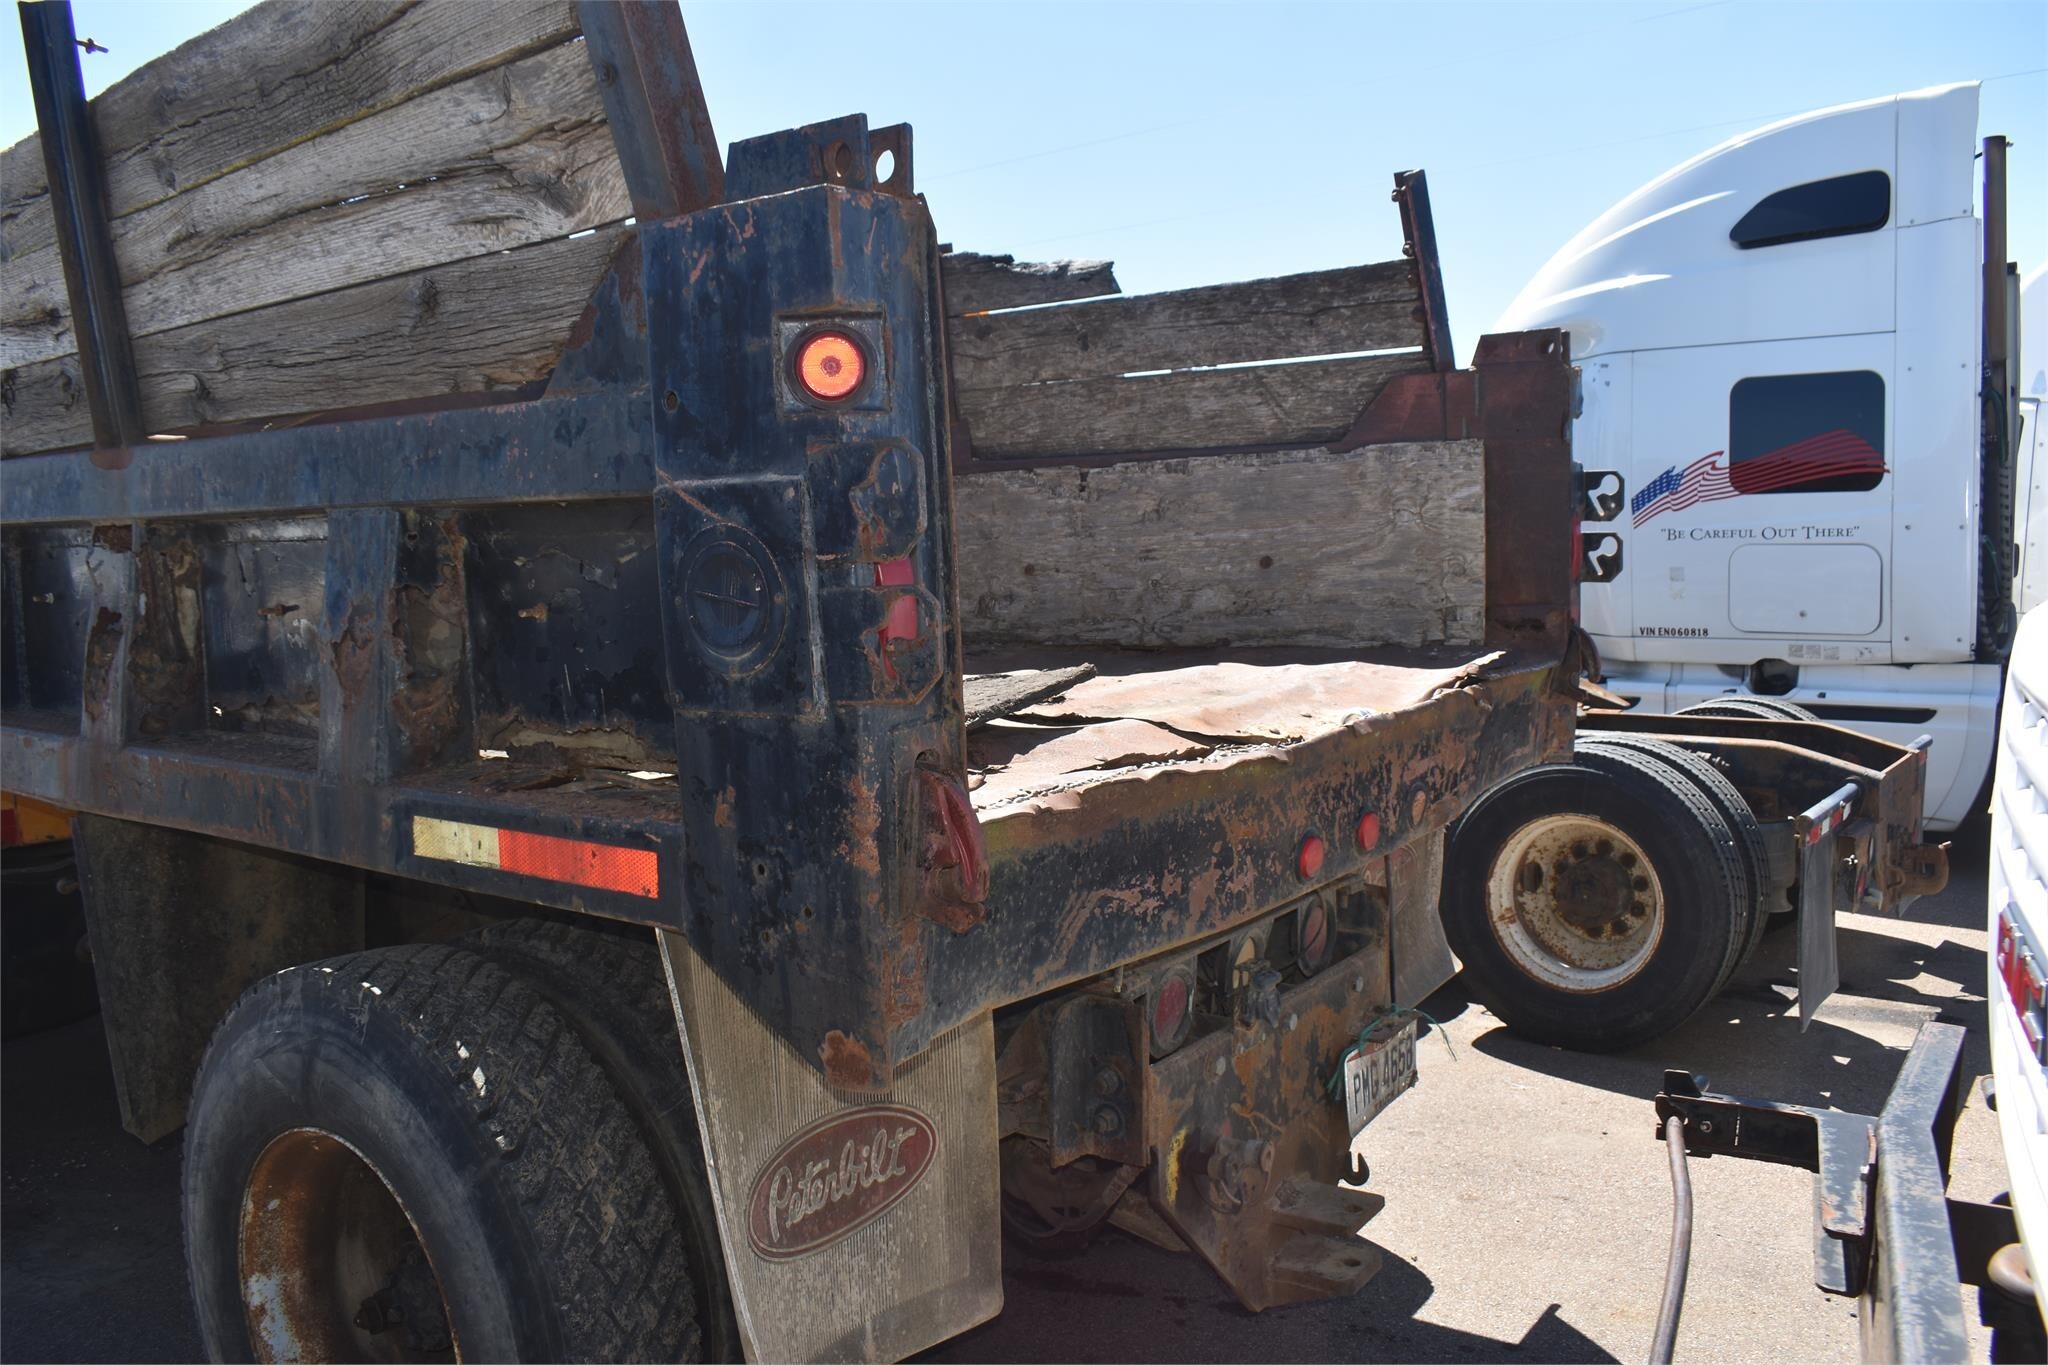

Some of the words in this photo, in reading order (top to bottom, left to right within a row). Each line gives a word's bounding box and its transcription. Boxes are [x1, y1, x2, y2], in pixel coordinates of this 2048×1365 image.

[1690, 527, 1756, 541] CAREFUL
[1761, 526, 1797, 540] OUT
[1639, 626, 1656, 636] VIN
[1657, 626, 1709, 637] EN060818
[768, 1127, 917, 1243] Peterbilt
